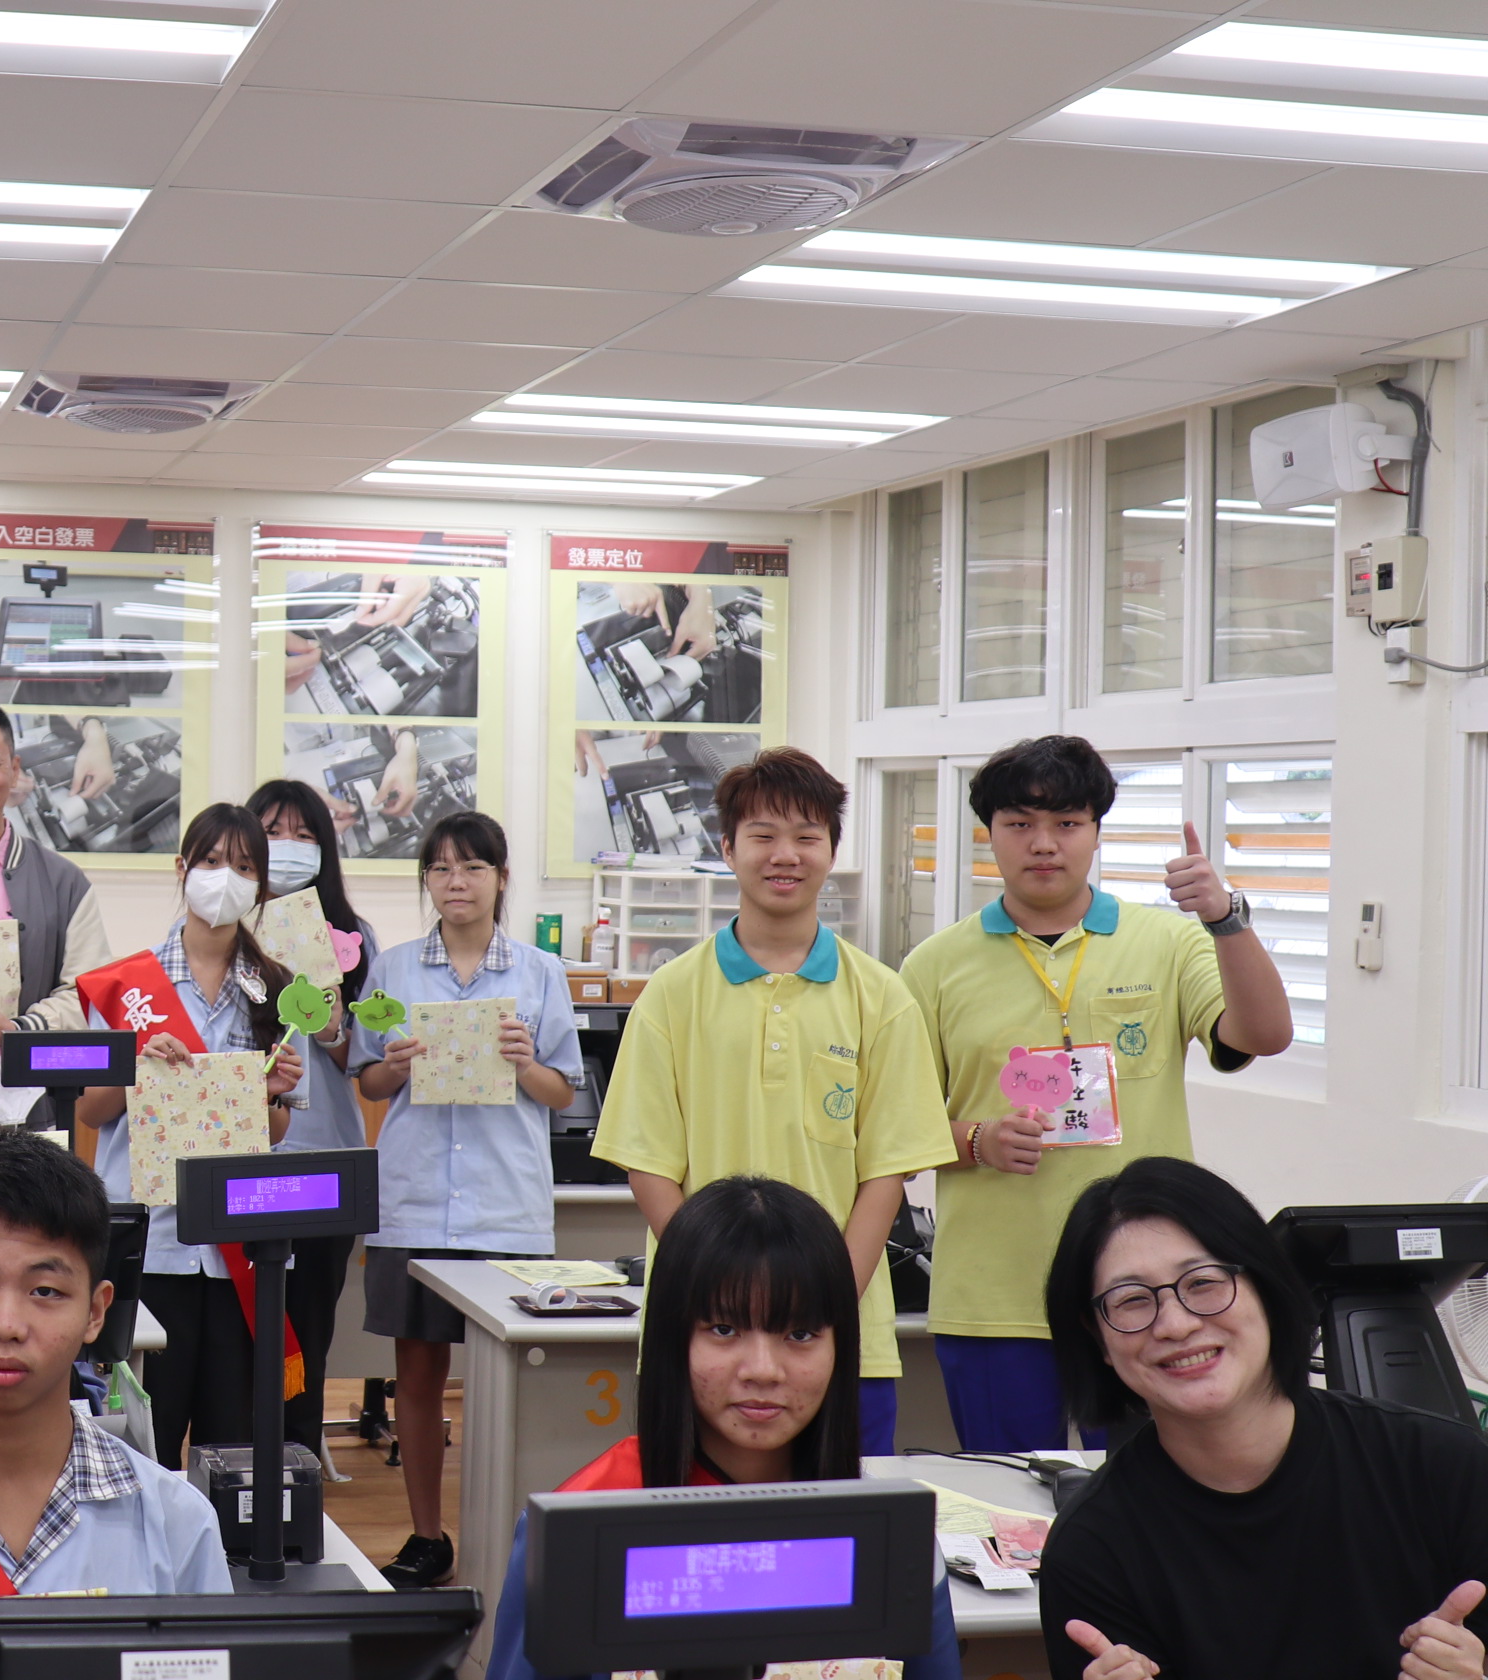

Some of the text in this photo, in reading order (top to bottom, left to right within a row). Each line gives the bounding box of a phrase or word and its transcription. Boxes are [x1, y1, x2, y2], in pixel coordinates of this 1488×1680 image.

[568, 547, 643, 569] 發票定位
[121, 987, 169, 1033] 最
[585, 1370, 621, 1426] 3
